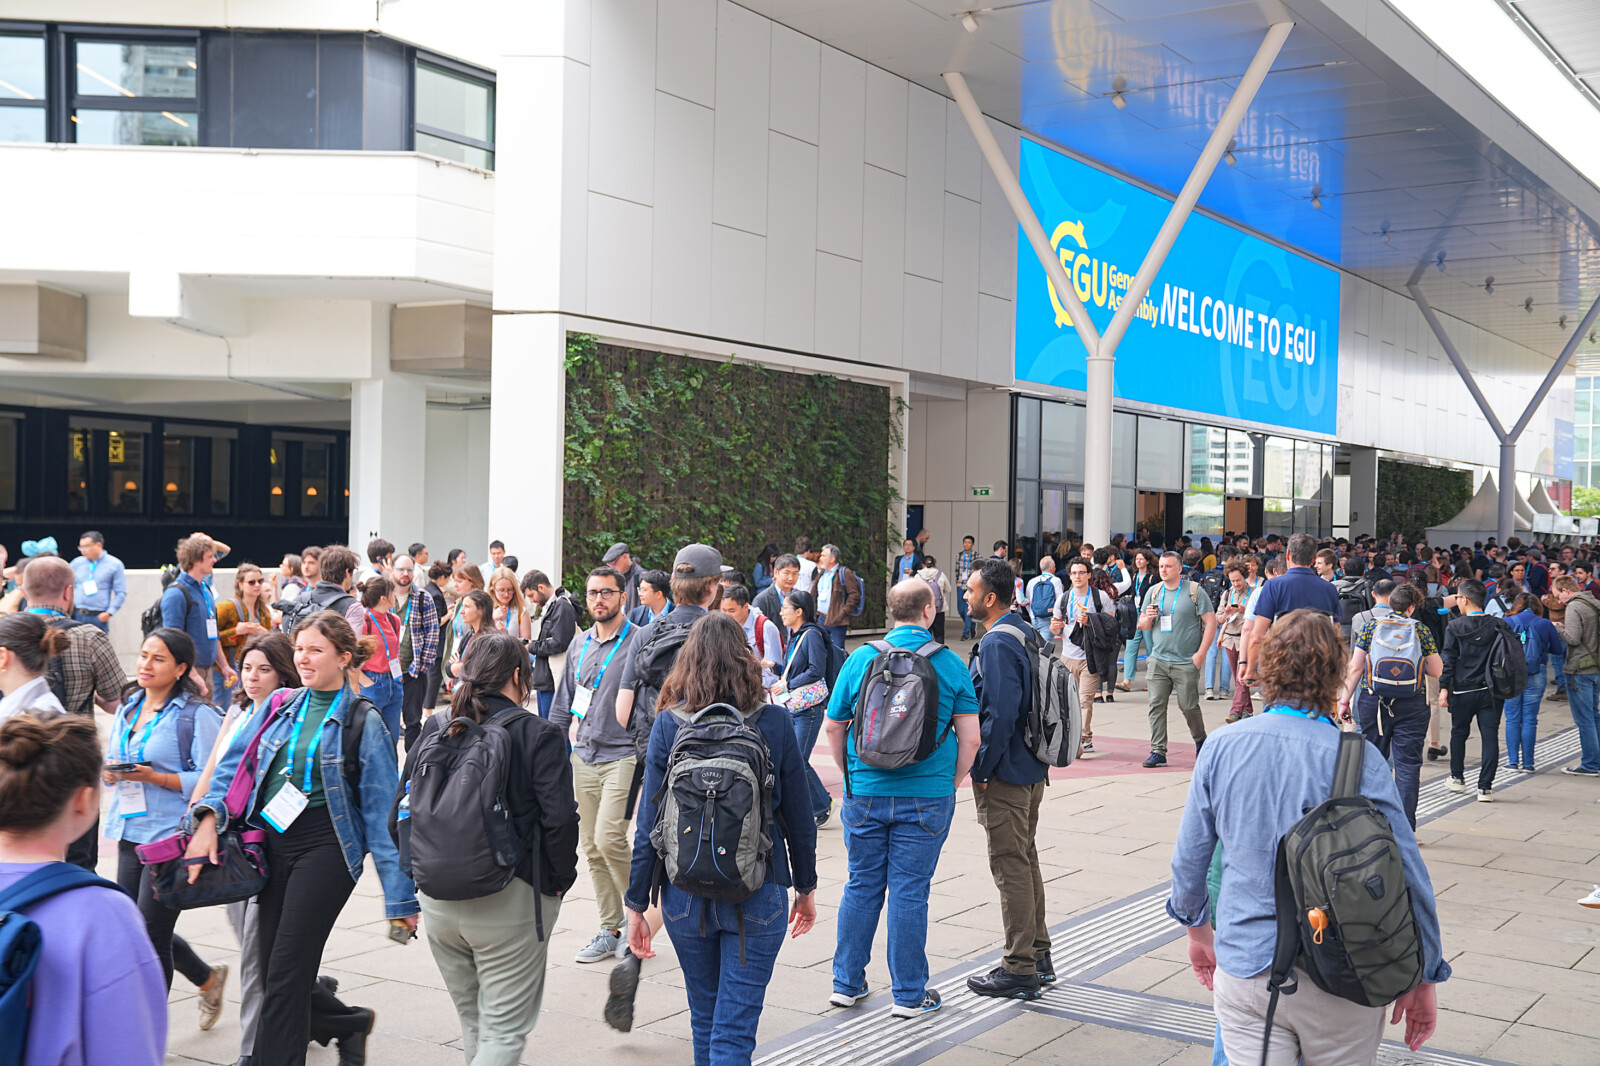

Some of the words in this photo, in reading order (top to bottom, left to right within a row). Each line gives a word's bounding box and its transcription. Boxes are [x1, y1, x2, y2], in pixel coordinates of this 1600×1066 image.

[1059, 247, 1108, 307] EGU
[1107, 288, 1159, 328] Asmbly
[1160, 282, 1254, 349] WELCOME
[1257, 312, 1281, 356] TO
[1284, 322, 1316, 366] EGU
[701, 771, 723, 779] OSPREY
